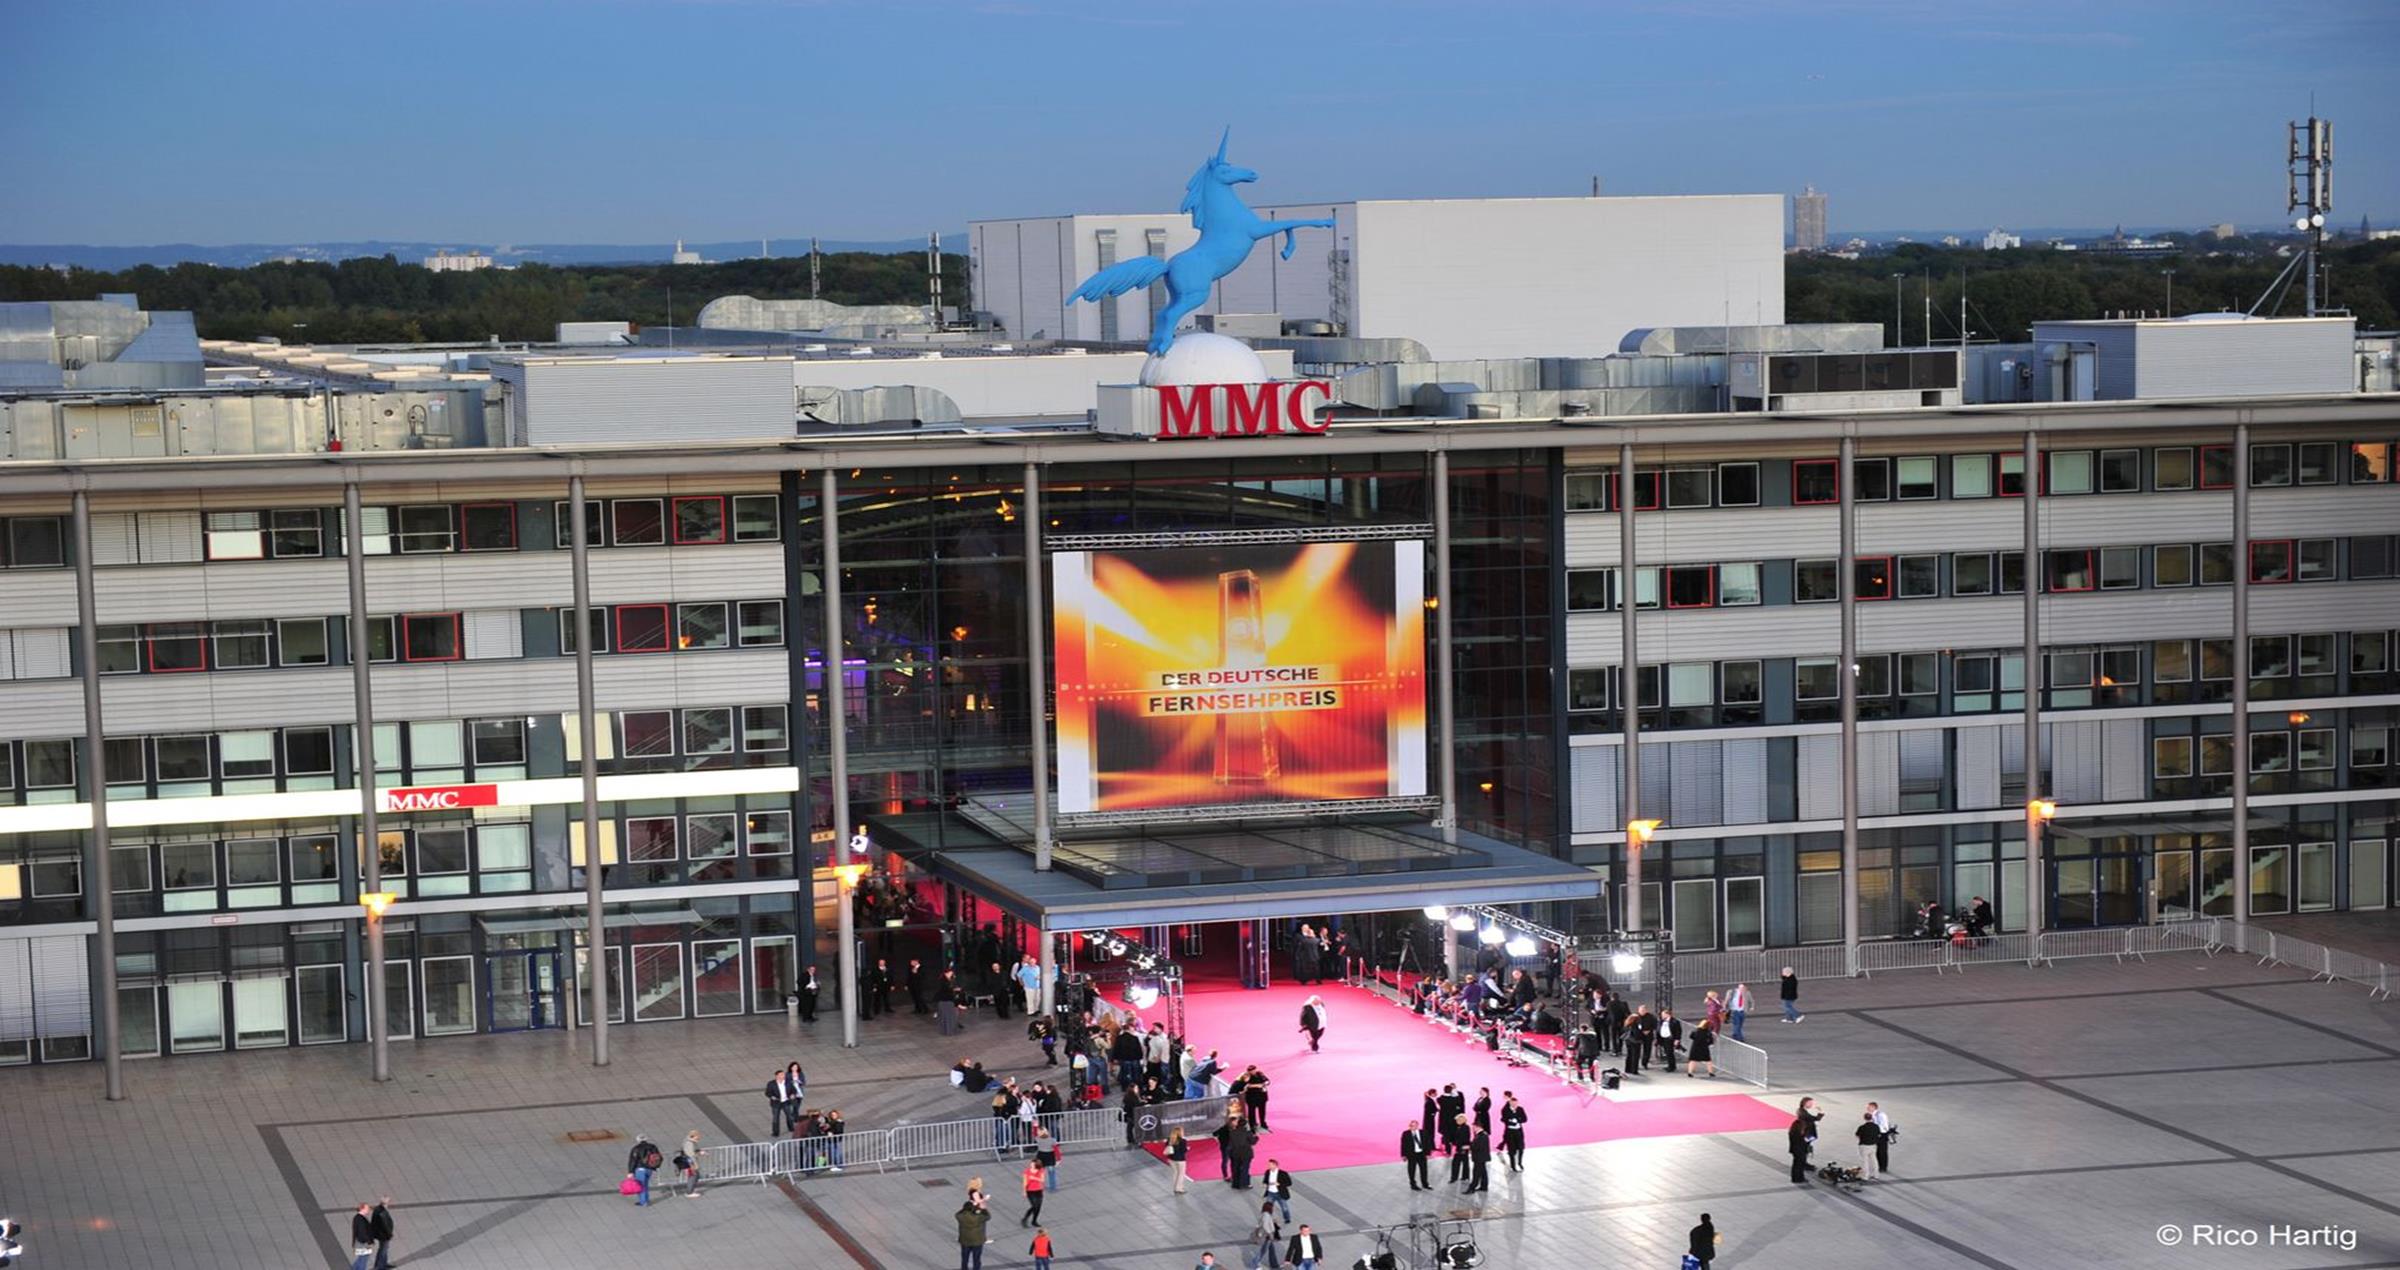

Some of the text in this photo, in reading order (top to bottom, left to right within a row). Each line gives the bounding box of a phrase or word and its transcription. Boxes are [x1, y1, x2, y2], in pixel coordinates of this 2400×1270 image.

[1154, 381, 1333, 440] MMC
[1162, 668, 1319, 686] DER DEUTSCHE
[1149, 690, 1336, 712] FERNSEHPREIS
[389, 791, 459, 810] MMC
